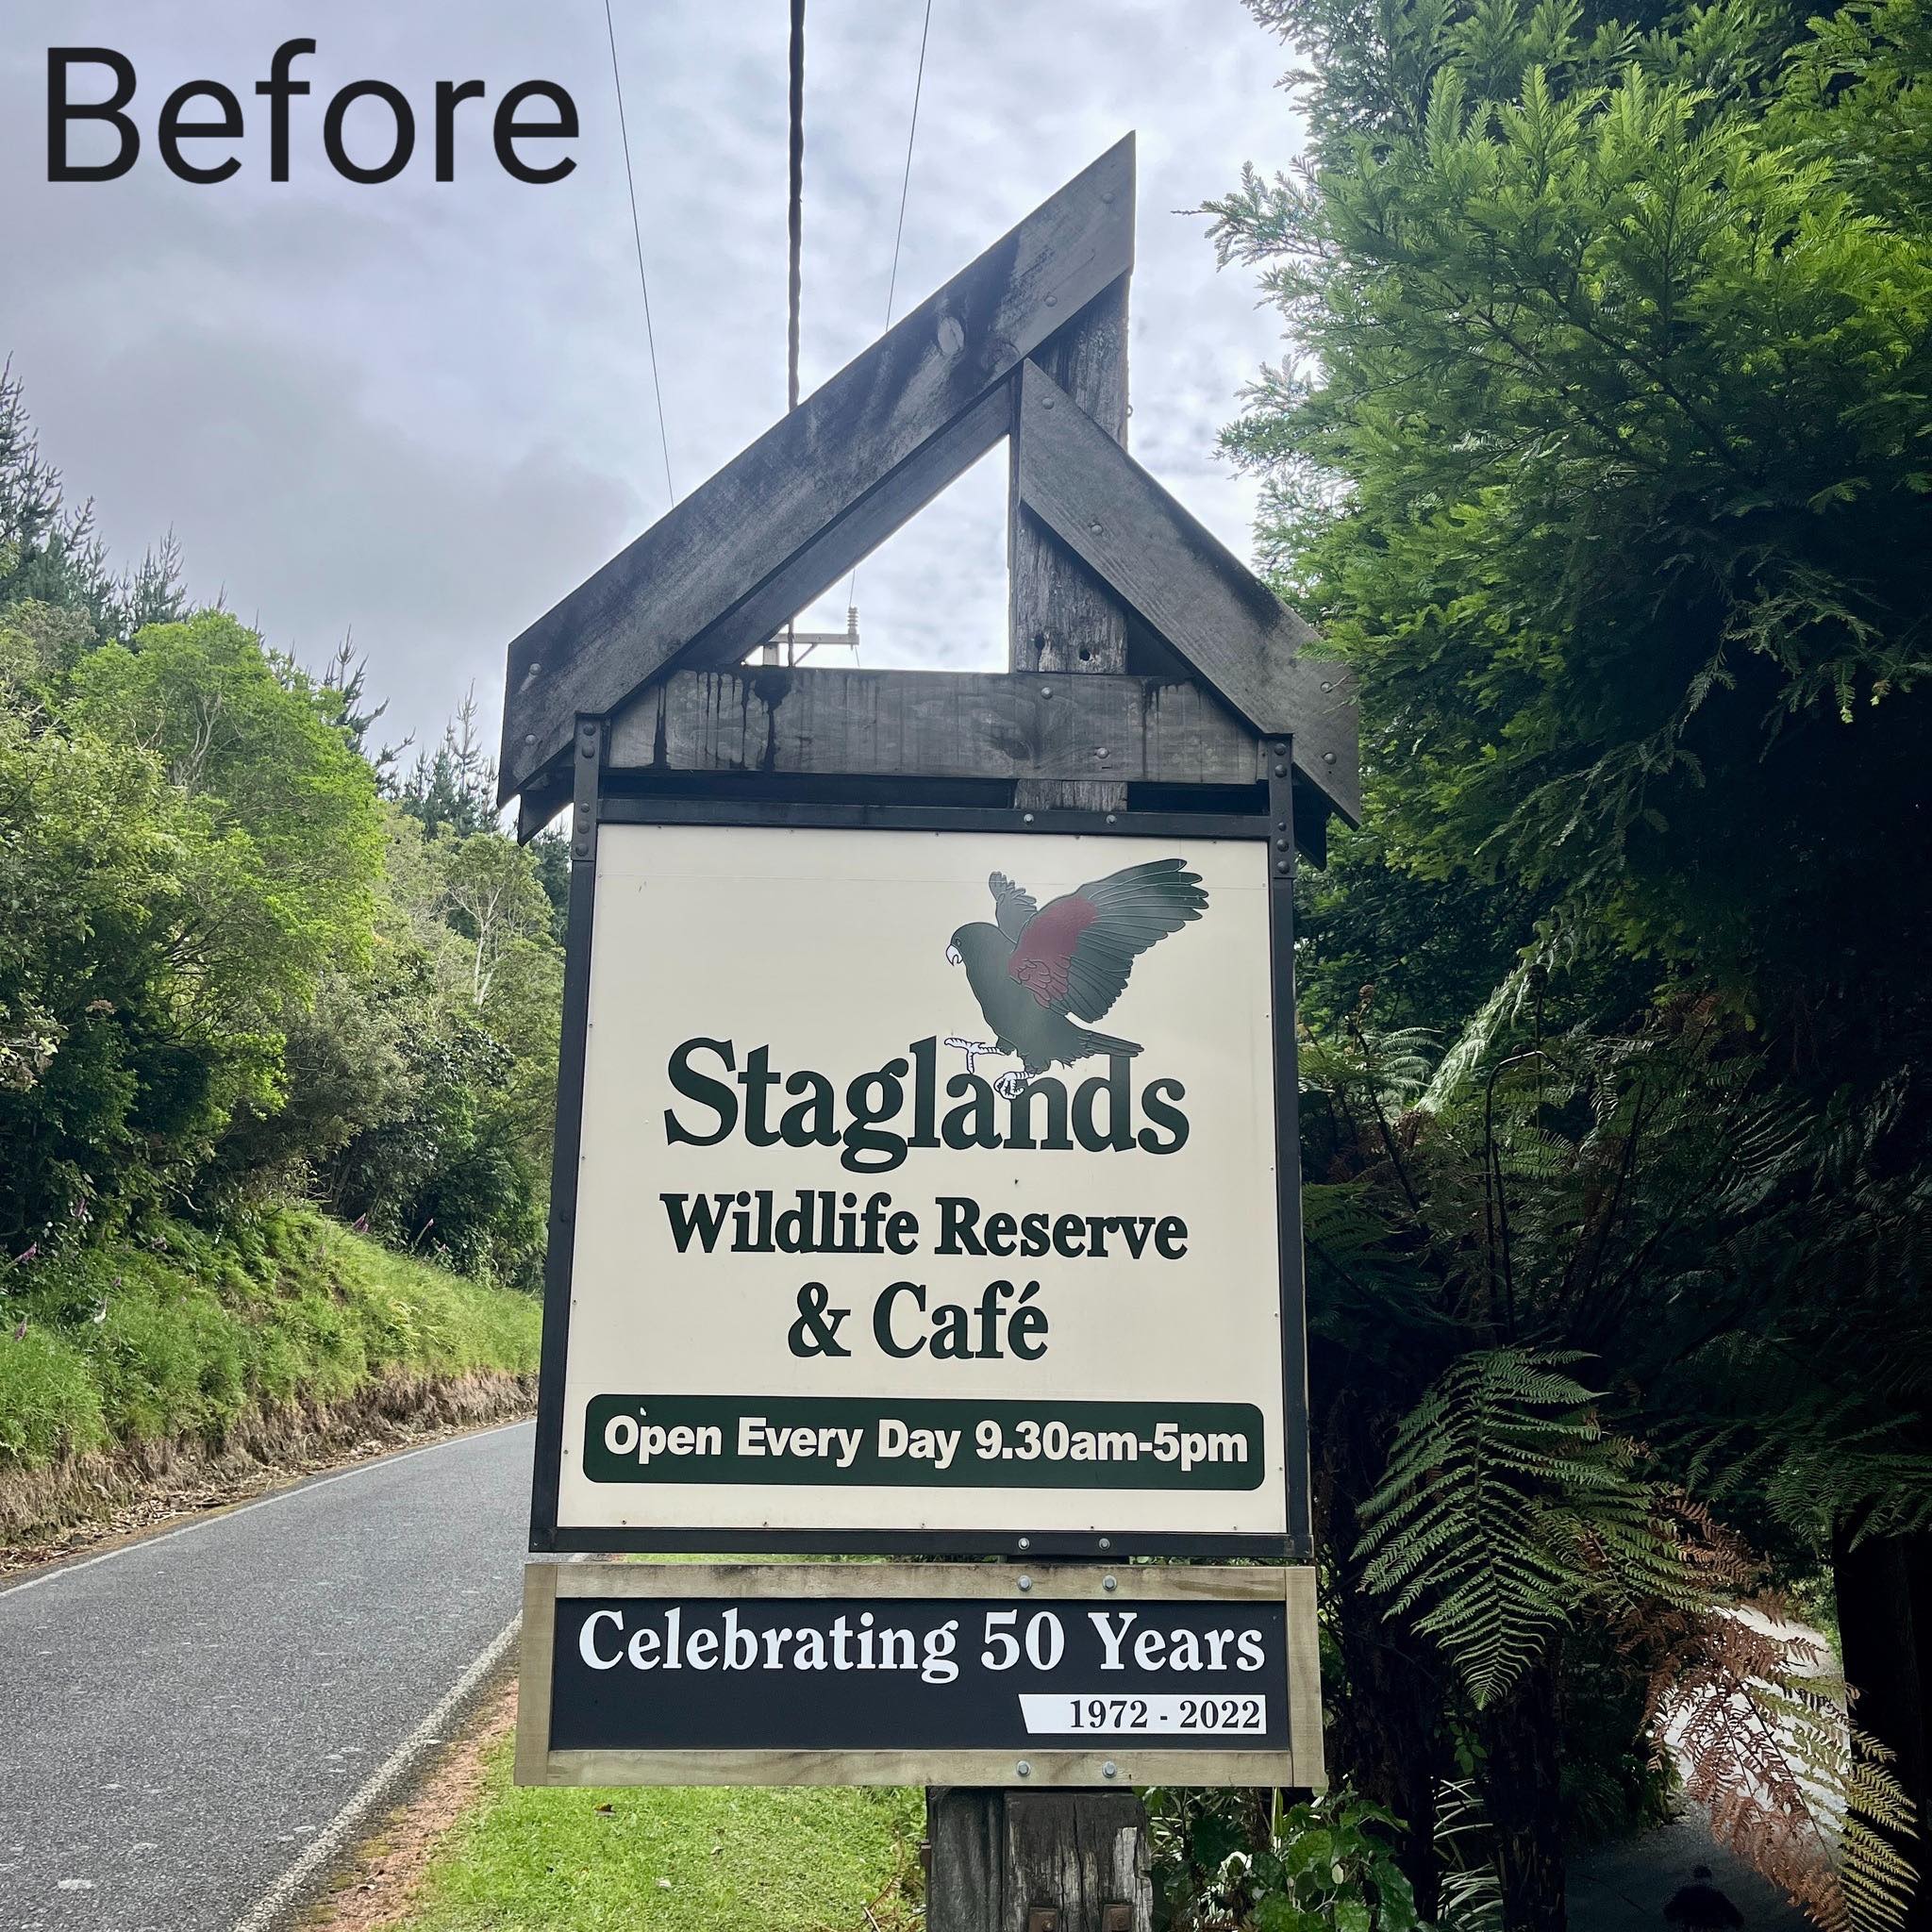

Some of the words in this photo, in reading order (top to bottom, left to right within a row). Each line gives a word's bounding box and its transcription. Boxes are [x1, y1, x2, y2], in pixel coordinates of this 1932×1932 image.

[663, 1036, 1190, 1174] Staglands
[659, 1190, 919, 1257] Wildlife
[934, 1196, 1189, 1260] Reserve
[788, 1281, 851, 1358] &
[873, 1279, 1049, 1360] Café
[604, 1415, 722, 1465] Open
[737, 1417, 862, 1468] Every
[877, 1420, 961, 1470] Day
[974, 1421, 1249, 1472] 9.30am-5pm
[578, 1607, 960, 1684] Celebrating
[981, 1608, 1066, 1672] 50
[1087, 1611, 1266, 1673] Years
[1070, 1700, 1148, 1728] 1972
[1179, 1700, 1260, 1728] 2022
